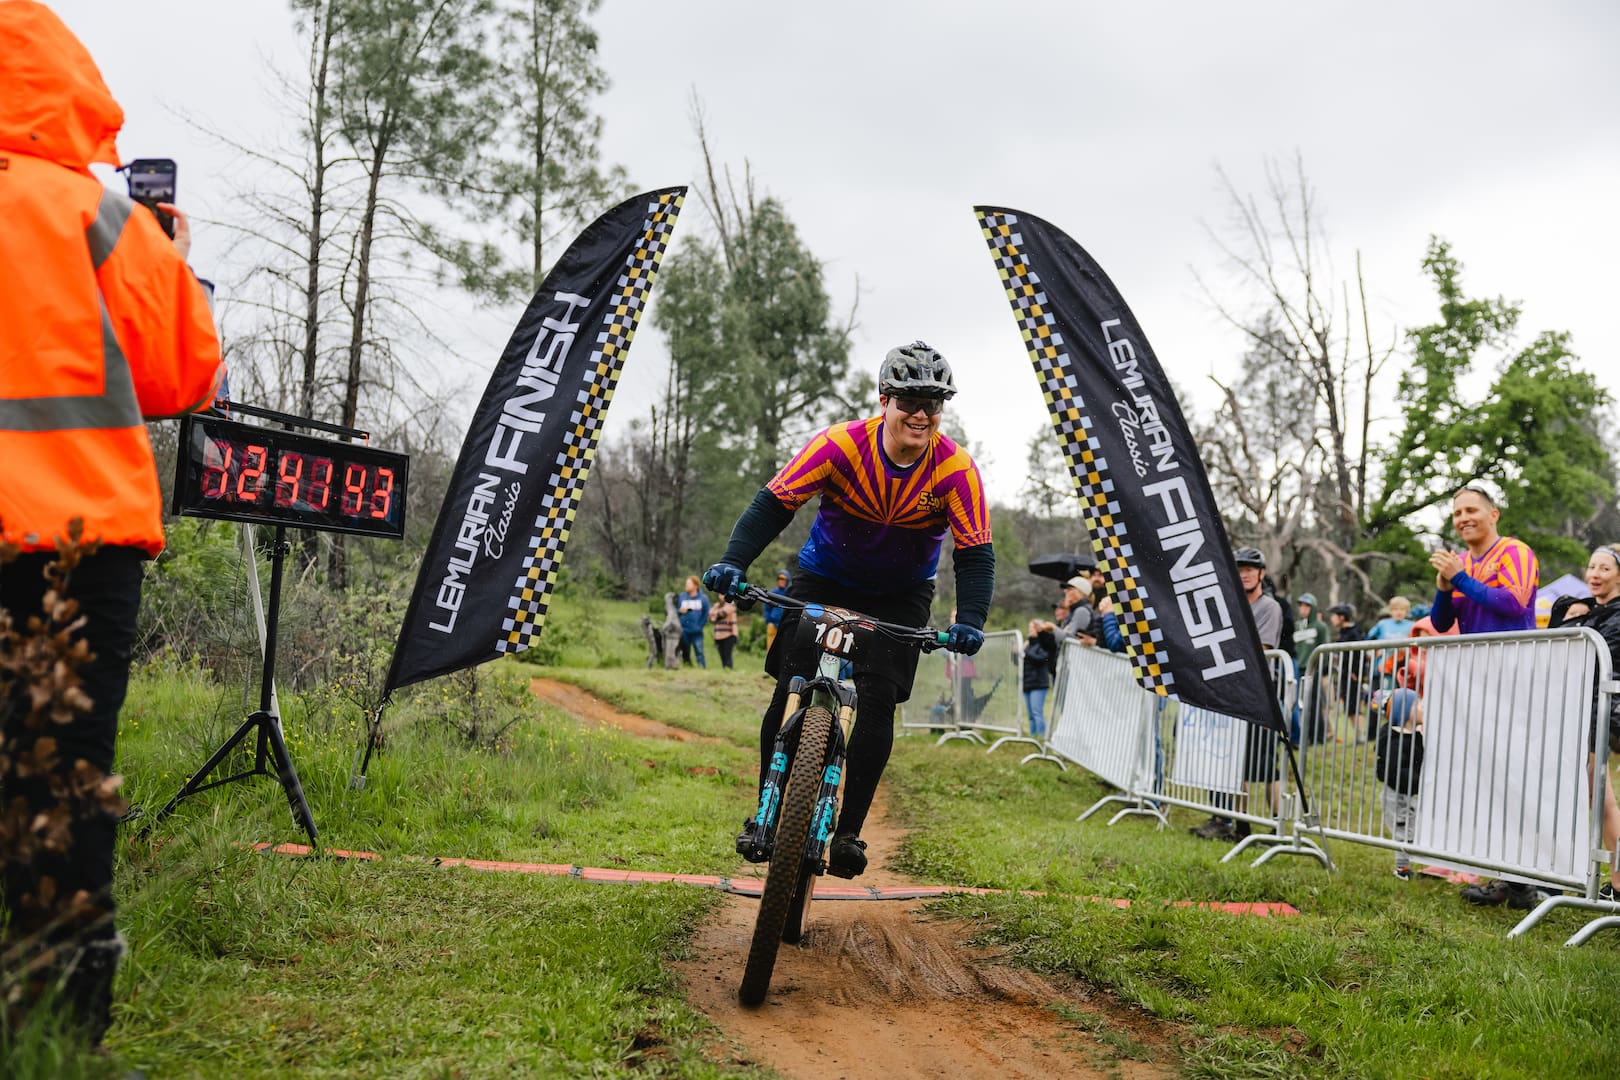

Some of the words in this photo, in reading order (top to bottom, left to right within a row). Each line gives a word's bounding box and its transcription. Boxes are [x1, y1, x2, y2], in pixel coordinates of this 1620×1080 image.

[485, 290, 592, 475] FINISH
[1100, 317, 1180, 472] LEMURIAN
[1111, 399, 1148, 478] Classic
[428, 472, 502, 634] LEMURIAN
[483, 481, 521, 560] Classic
[1141, 475, 1247, 681] FINISH
[814, 622, 855, 653] 101
